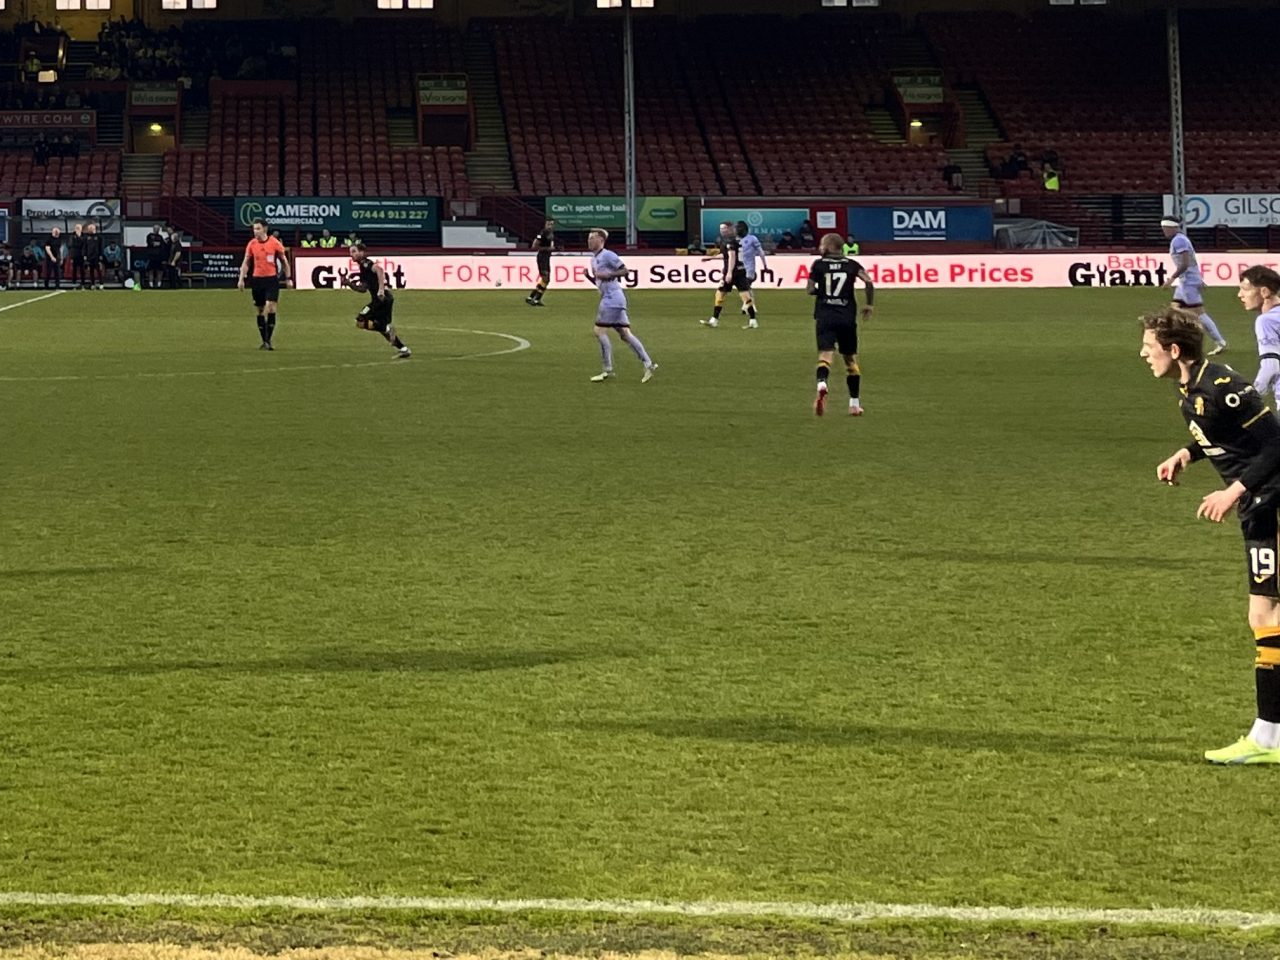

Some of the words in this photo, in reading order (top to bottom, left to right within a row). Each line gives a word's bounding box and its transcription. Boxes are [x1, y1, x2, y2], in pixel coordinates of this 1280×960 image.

[264, 204, 340, 217] CAMERON
[352, 210, 385, 220] 07444
[388, 210, 407, 220] 913
[408, 210, 428, 220] 227
[552, 204, 574, 212] Can't
[576, 204, 594, 213] spot
[596, 204, 611, 212] the
[892, 210, 946, 230] DAM
[1108, 255, 1157, 269] Bath
[442, 266, 491, 283] FOR
[502, 265, 585, 283] TRDE
[950, 263, 1034, 283] Prices
[1068, 262, 1168, 287] Giant
[824, 272, 848, 297] 17
[1250, 547, 1275, 576] 19
